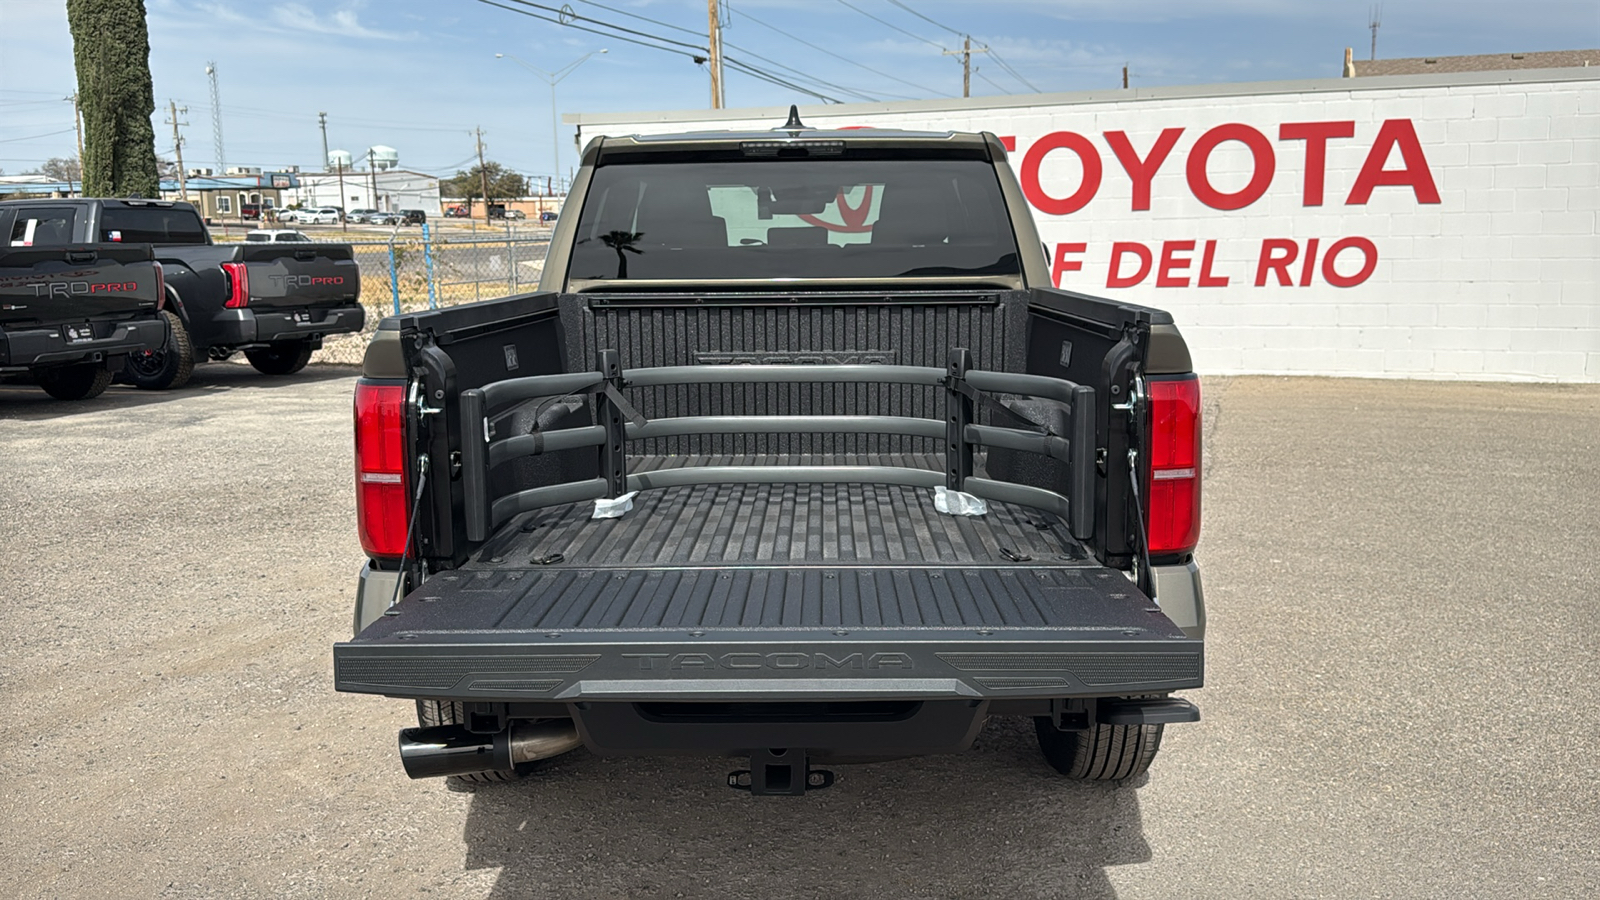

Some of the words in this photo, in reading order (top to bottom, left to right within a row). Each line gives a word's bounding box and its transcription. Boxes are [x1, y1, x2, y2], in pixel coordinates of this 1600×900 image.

[1000, 118, 1442, 216] OYOTA
[1051, 242, 1087, 289] F
[1106, 239, 1230, 289] DEL
[1254, 236, 1378, 288] RIO
[27, 281, 89, 299] TRD
[91, 282, 137, 293] PRO
[268, 275, 311, 289] TRD
[312, 276, 343, 285] PRO
[621, 652, 913, 670] TACOMA
